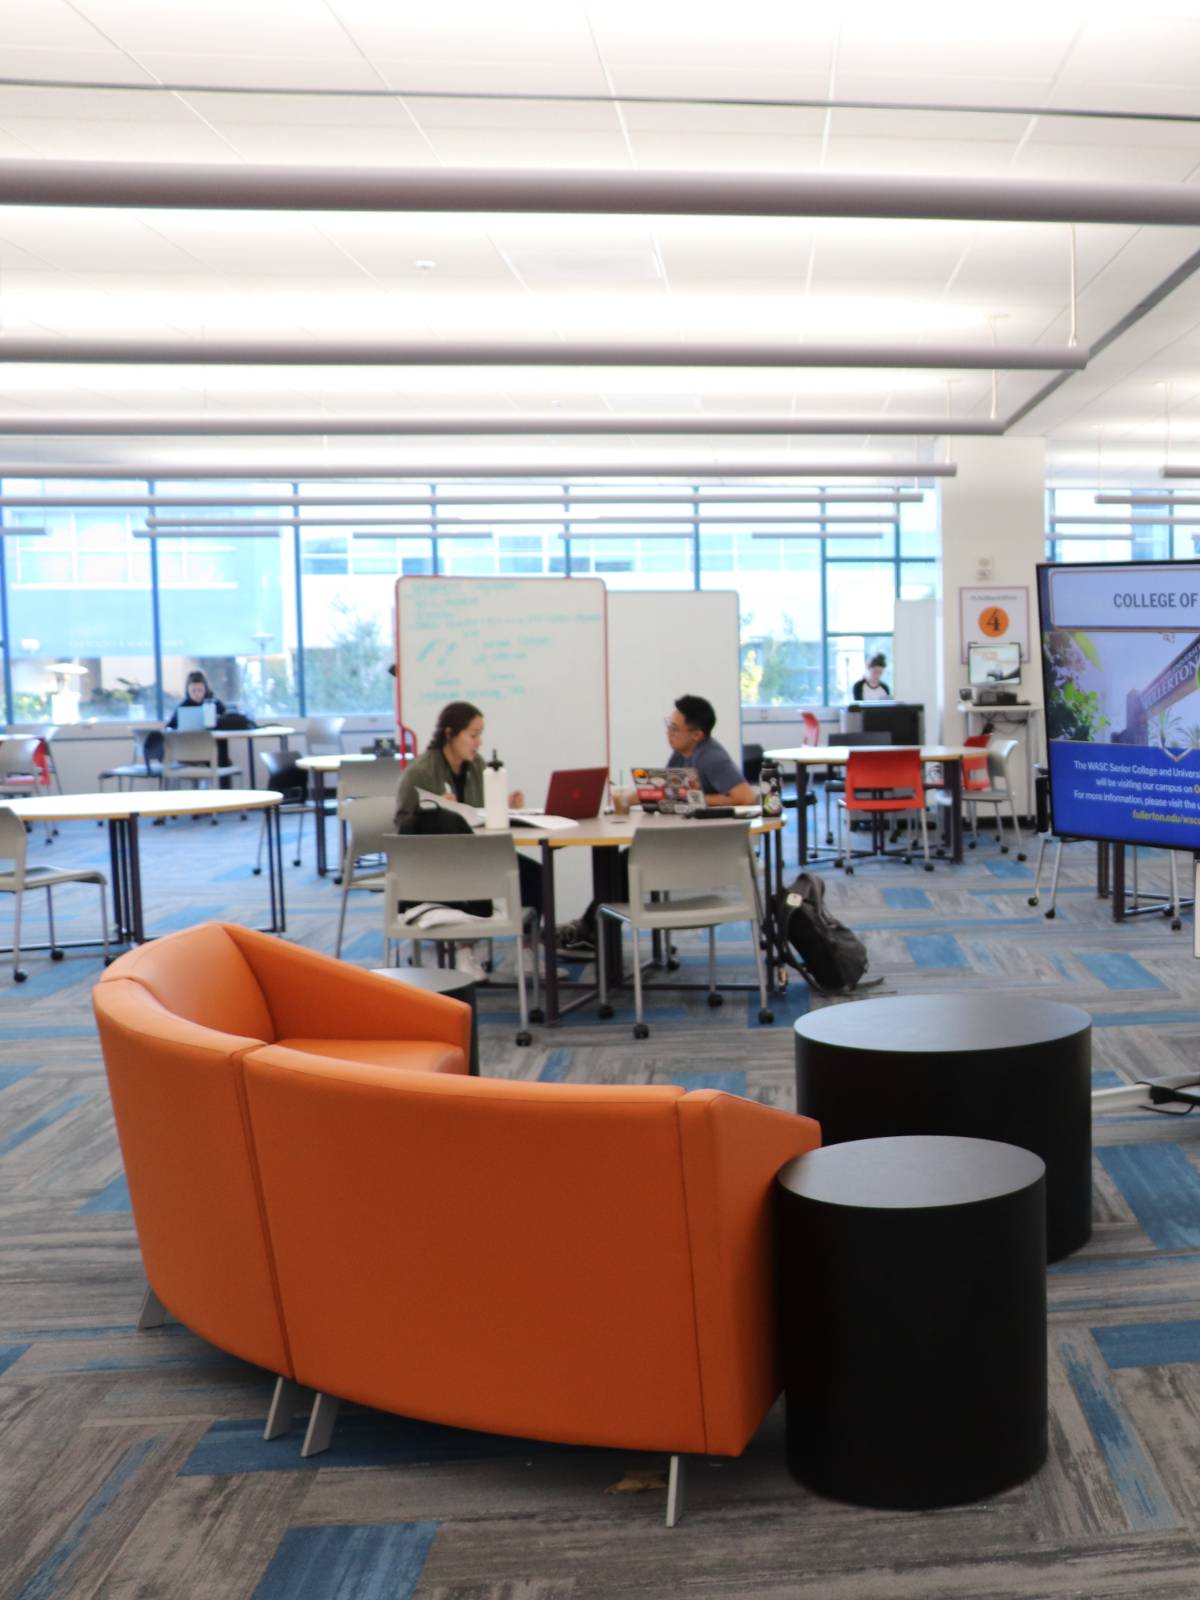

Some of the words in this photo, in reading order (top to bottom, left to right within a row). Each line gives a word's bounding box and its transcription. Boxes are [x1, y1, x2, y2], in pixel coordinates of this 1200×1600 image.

[1113, 592, 1176, 608] COLLEGE
[1179, 592, 1198, 608] OF
[986, 608, 1001, 631] 4
[1074, 760, 1087, 770] The
[1087, 761, 1108, 772] WASC
[1110, 762, 1131, 773] Senior
[1132, 765, 1158, 777] College
[1159, 768, 1172, 777] and
[1096, 778, 1107, 786] will
[1108, 779, 1116, 787] be
[1118, 779, 1142, 790] visiting
[1143, 782, 1154, 790] our
[1155, 783, 1182, 793] campus
[1183, 785, 1193, 793] on
[1073, 790, 1084, 799] For
[1085, 792, 1102, 800] more
[1145, 797, 1167, 807] please
[1168, 799, 1182, 808] visit
[1184, 800, 1196, 809] the
